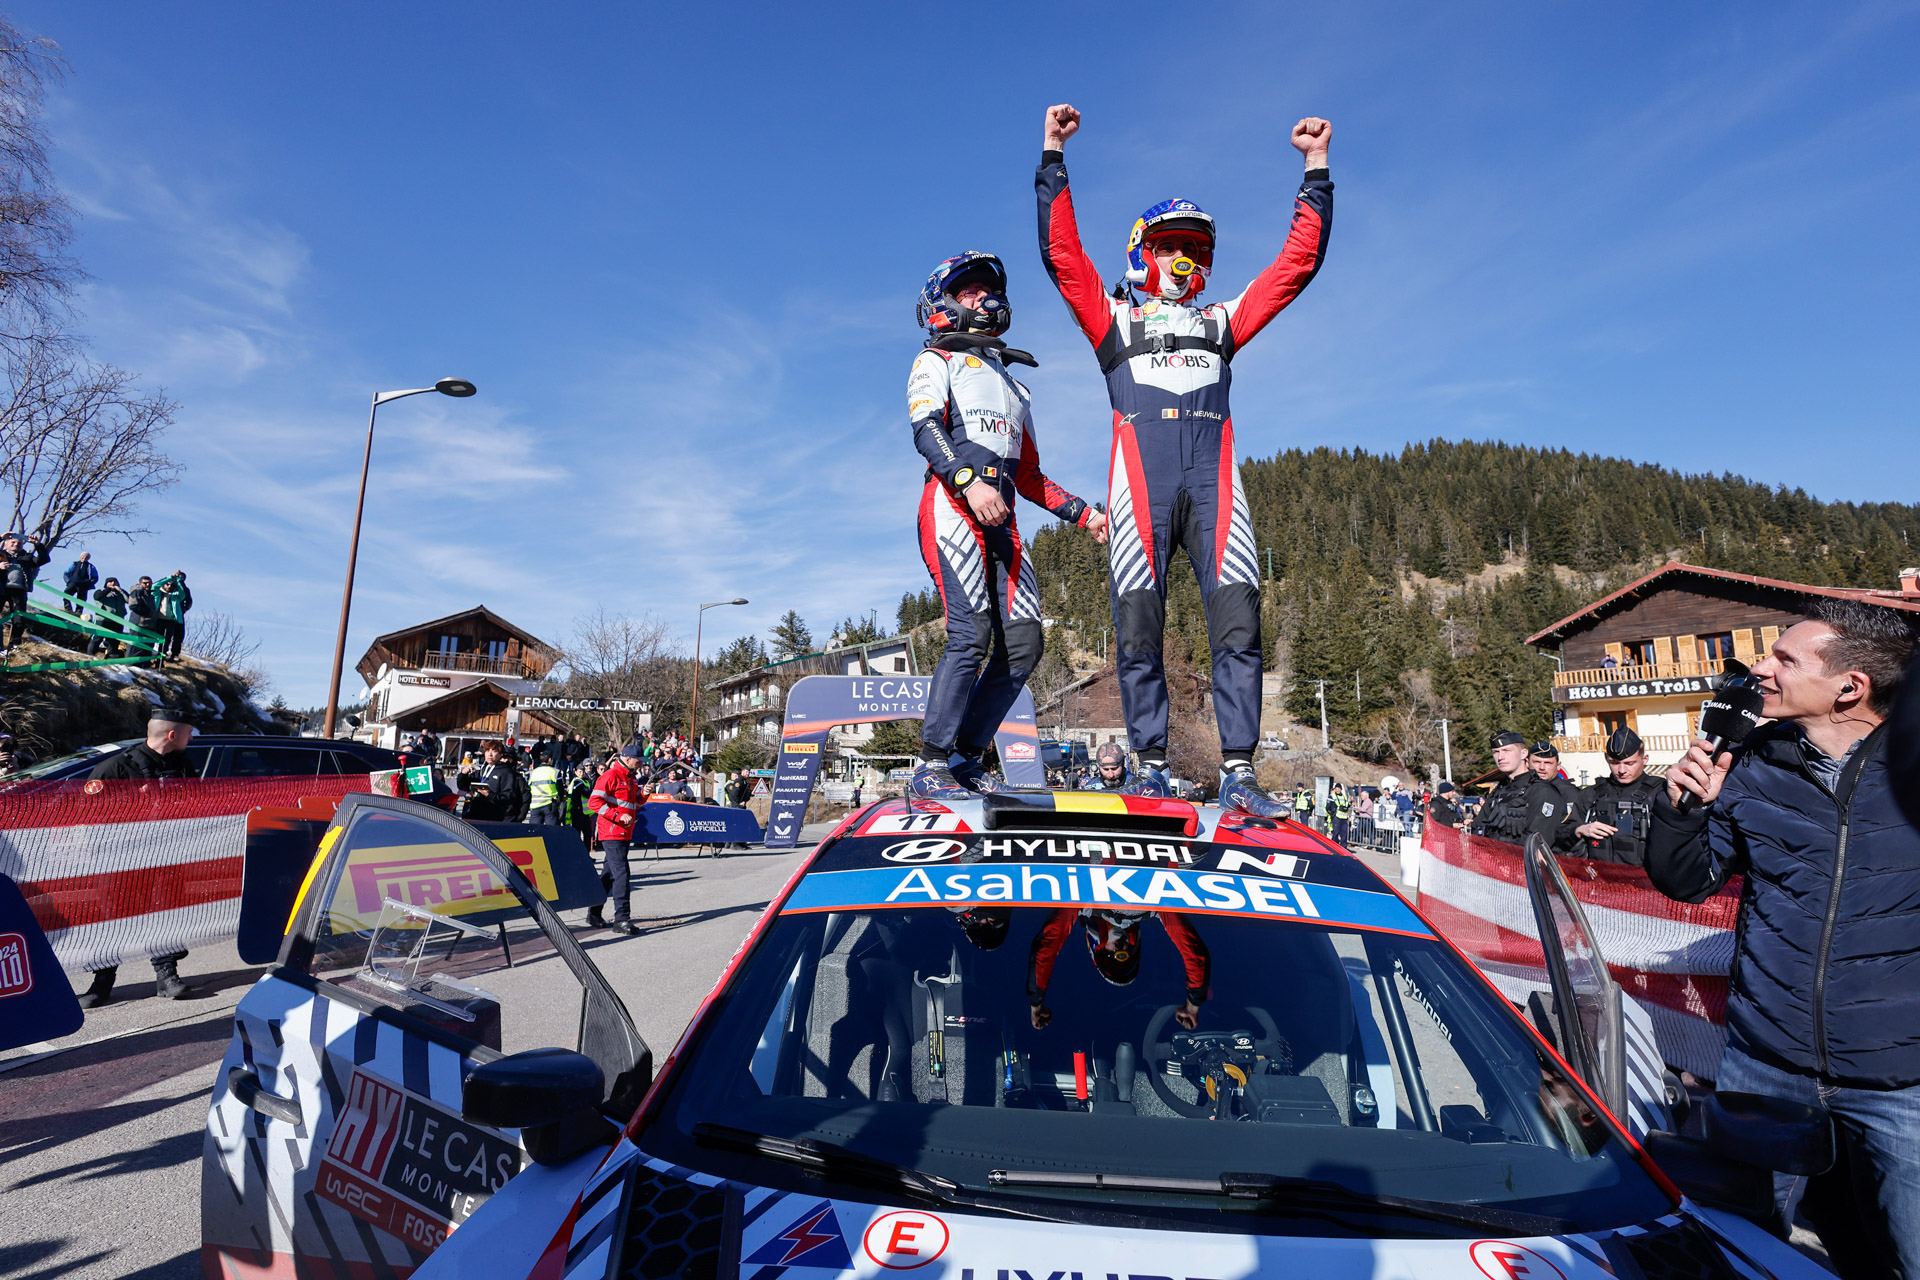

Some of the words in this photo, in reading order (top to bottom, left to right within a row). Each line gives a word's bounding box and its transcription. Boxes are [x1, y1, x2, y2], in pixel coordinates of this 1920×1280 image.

[1150, 354, 1210, 369] MOBIS
[1185, 409, 1192, 417] T.
[1193, 410, 1222, 420] NEUVILLE
[931, 428, 956, 462] HYUNDAI
[399, 676, 420, 684] HOTEL
[852, 681, 875, 699] LE
[1568, 685, 1613, 700] Hôtel
[1618, 682, 1648, 697] des
[1651, 678, 1702, 694] Trois
[580, 699, 605, 710] COL
[898, 814, 941, 831] 11
[983, 839, 1193, 864] HYUNDAI
[885, 866, 1321, 918] AsahiKASEI
[402, 1109, 440, 1160] LE
[443, 1131, 527, 1194] CAS
[401, 1163, 476, 1218] MONTE
[325, 1172, 382, 1218] WRC
[403, 1212, 452, 1250] FOSS
[886, 1220, 925, 1256] E
